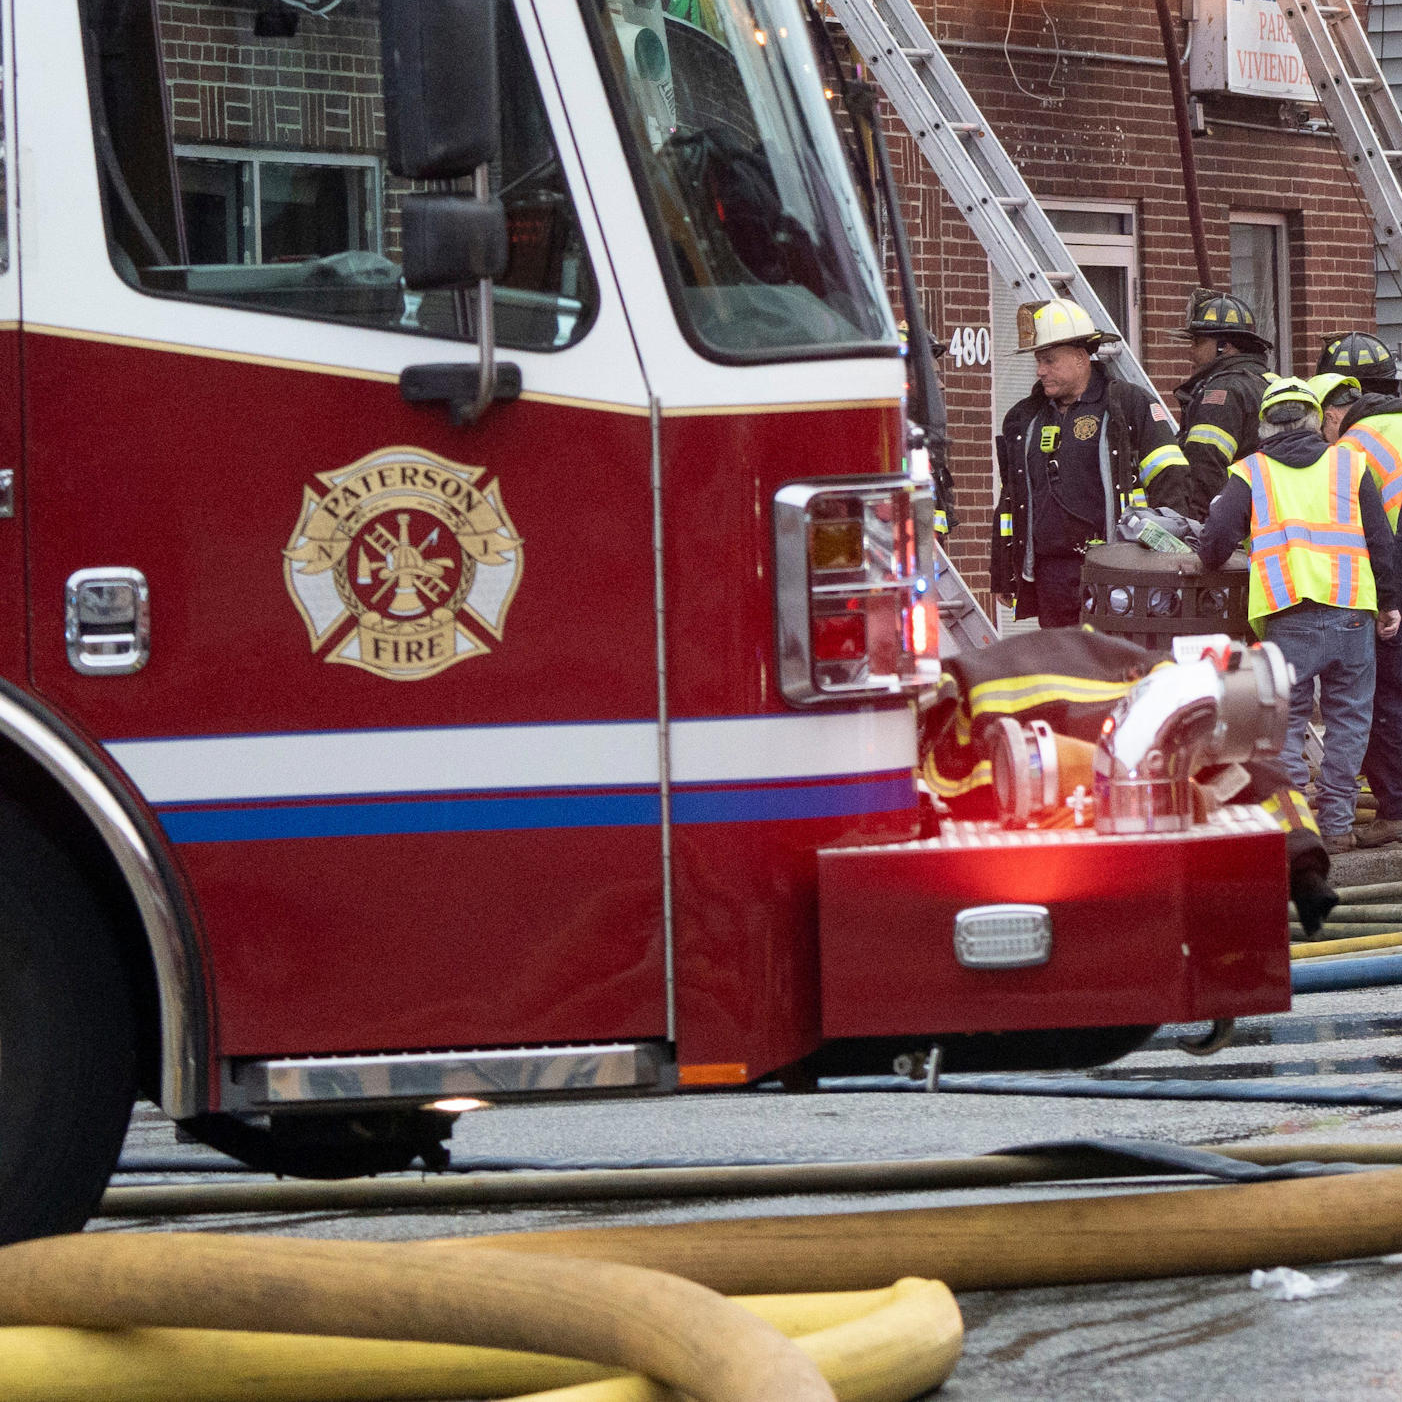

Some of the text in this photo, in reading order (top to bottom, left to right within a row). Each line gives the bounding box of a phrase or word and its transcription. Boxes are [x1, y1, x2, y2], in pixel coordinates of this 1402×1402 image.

[949, 327, 990, 368] 480
[322, 466, 483, 520] PATERSON
[371, 631, 446, 663] FIRE
